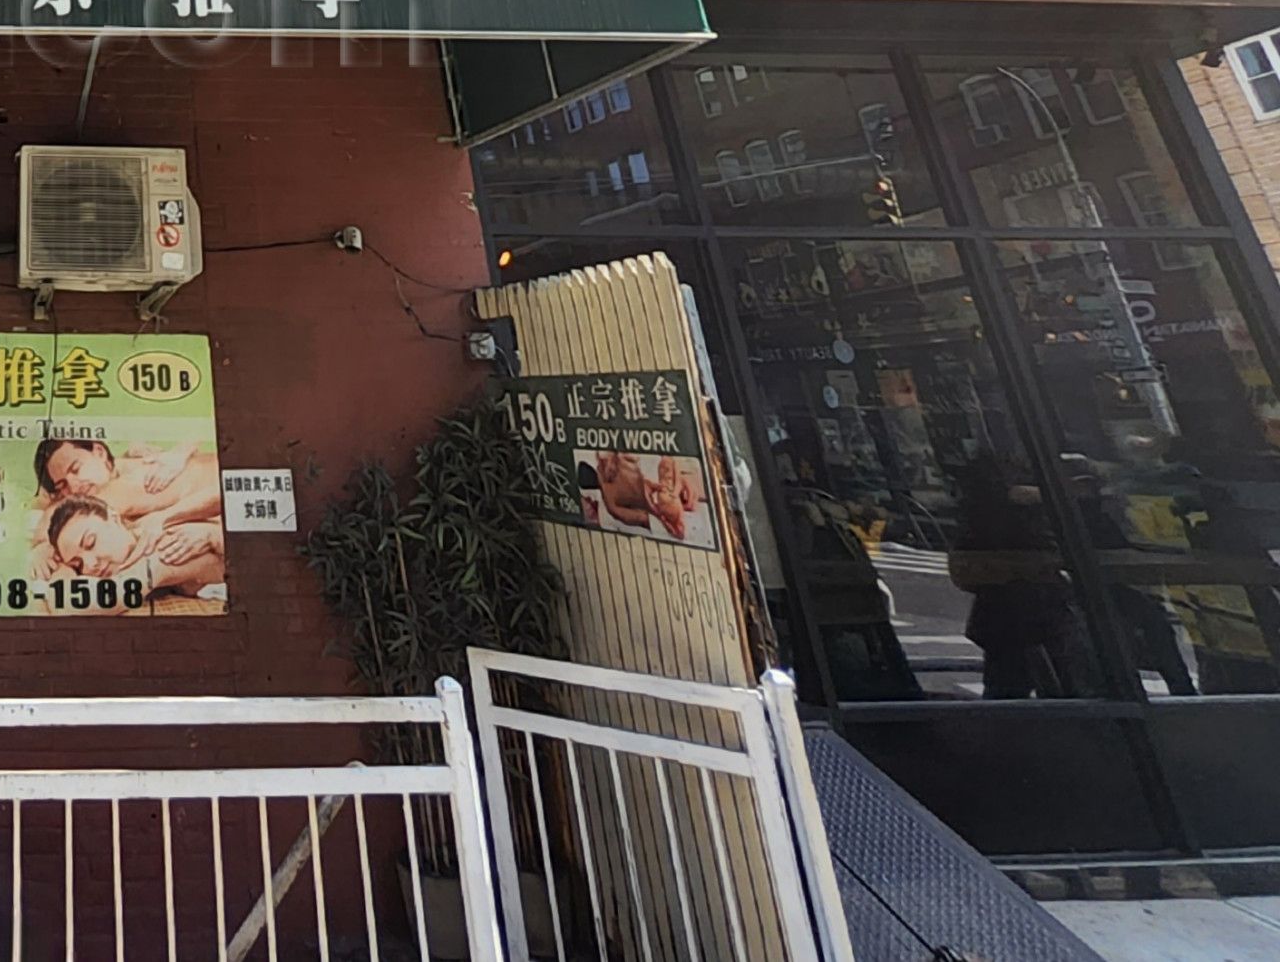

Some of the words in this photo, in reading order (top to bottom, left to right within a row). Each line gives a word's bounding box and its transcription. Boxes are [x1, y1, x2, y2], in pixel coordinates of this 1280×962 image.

[128, 363, 172, 393] 150
[564, 376, 682, 423] 正宗推拿
[36, 419, 108, 440] Tuina
[576, 427, 619, 449] BODY
[623, 429, 680, 453] WORK
